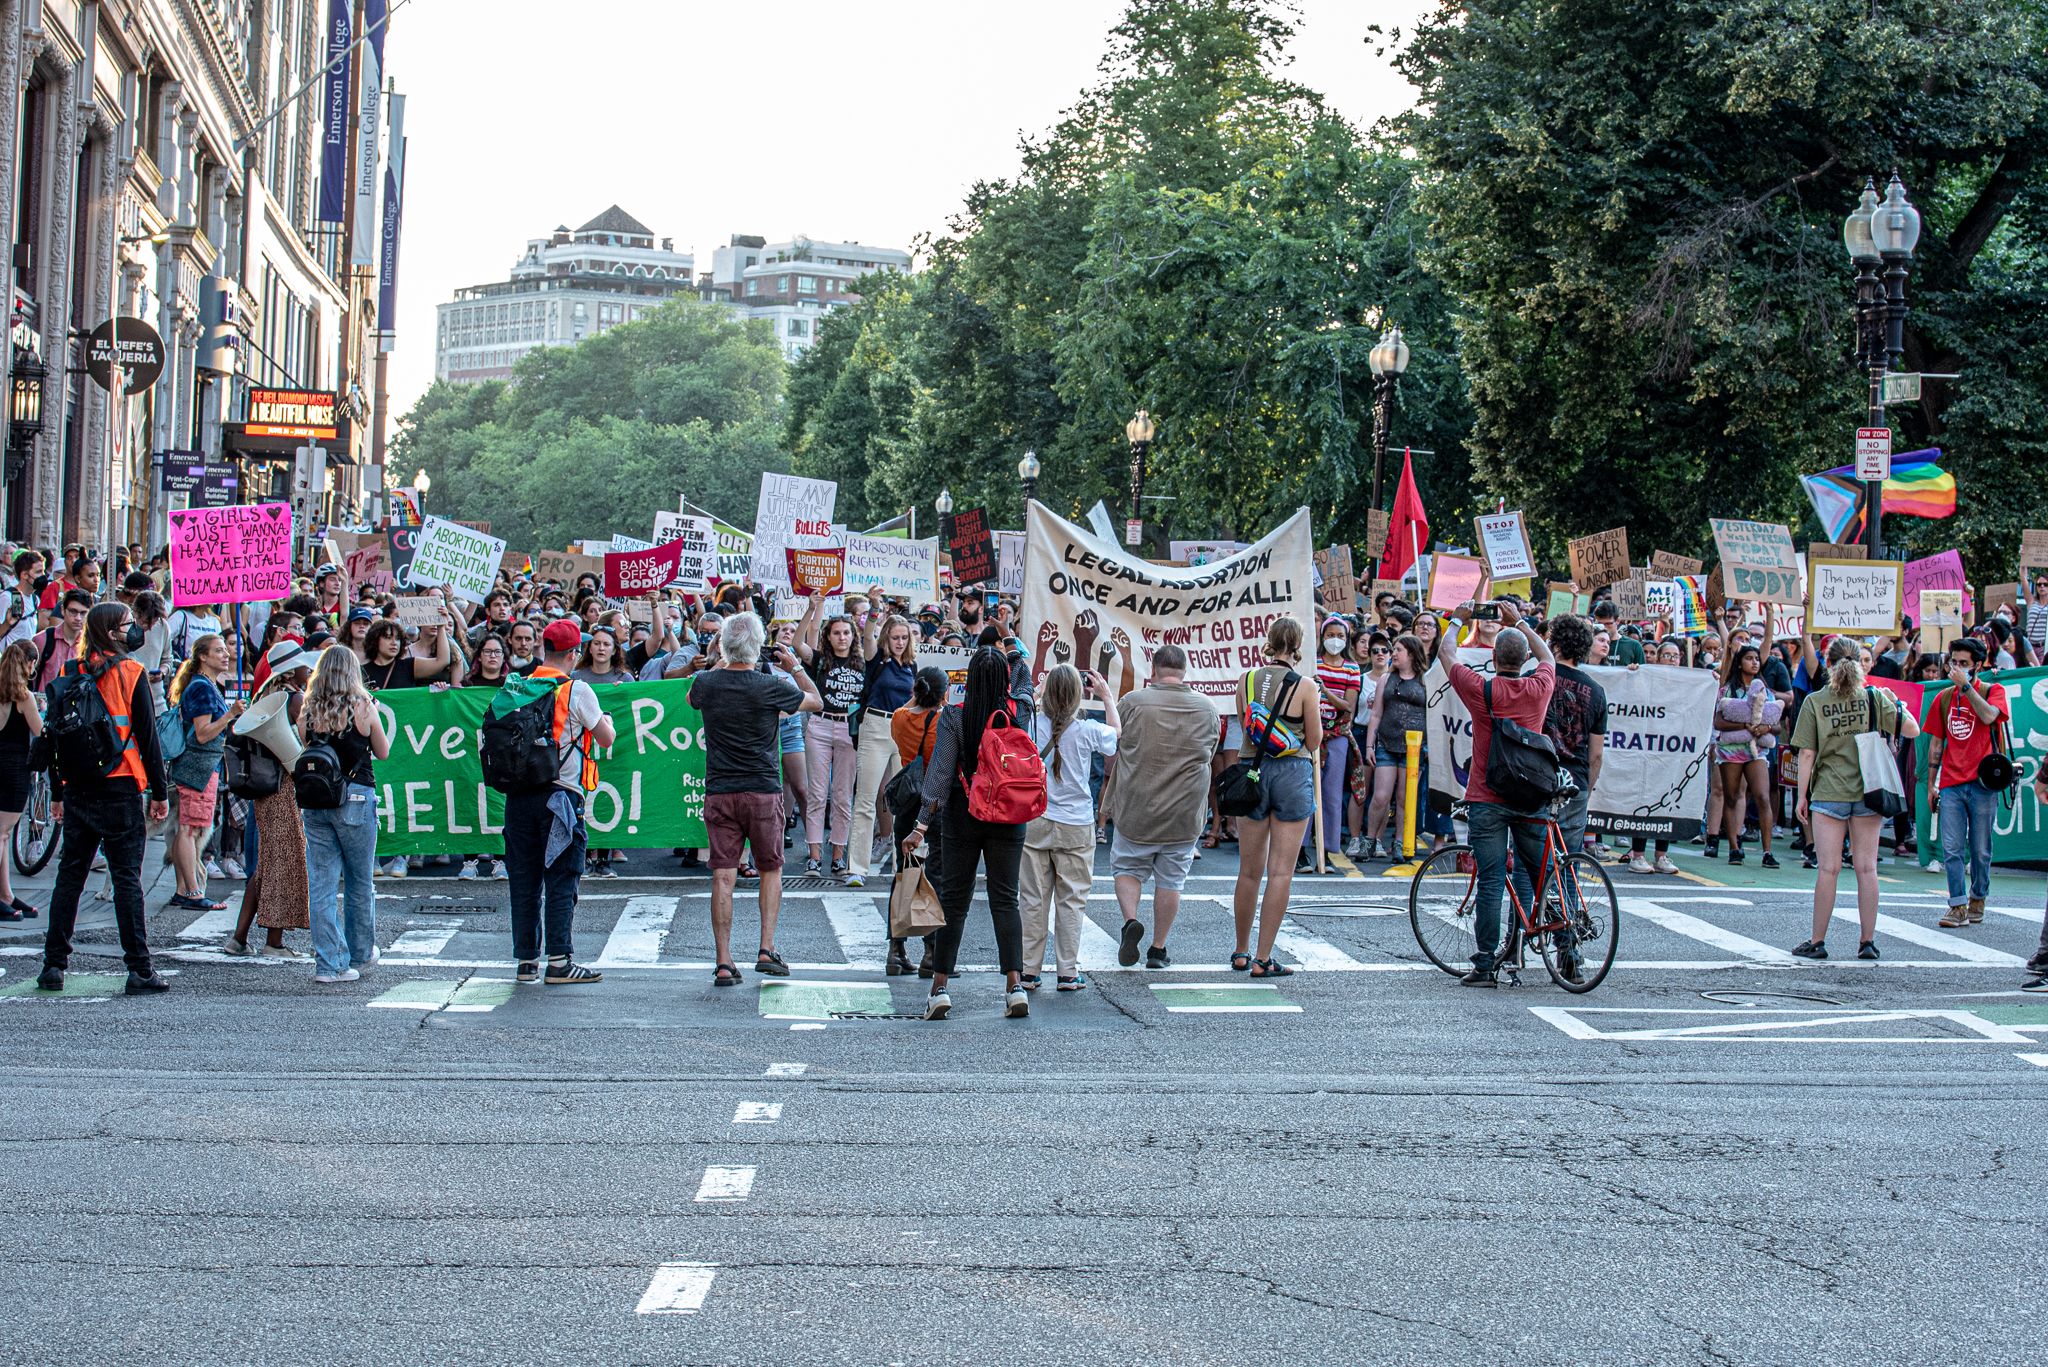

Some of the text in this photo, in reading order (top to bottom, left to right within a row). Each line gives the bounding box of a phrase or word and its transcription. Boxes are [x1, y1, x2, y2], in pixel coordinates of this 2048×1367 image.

[327, 19, 349, 145] Emerson College
[359, 85, 380, 197] Emerson College
[382, 201, 397, 287] Emerson College
[96, 339, 110, 349] EL
[251, 391, 333, 406] THE NEIL DIAMOND MUSICAL
[251, 402, 335, 426] A BEAUTIFUL NOISE
[169, 453, 200, 462] Emerson
[166, 475, 200, 484] Print-Copy
[205, 492, 228, 500] Building
[768, 474, 833, 506] IF MY
[205, 506, 261, 525] GIRLS
[391, 508, 417, 516] PARTY
[767, 497, 822, 519] UTERUS
[675, 518, 695, 529] THE
[954, 510, 980, 524] FIGHT
[1486, 520, 1514, 529] STOP
[185, 522, 290, 542] JUST WANNA
[758, 514, 831, 537] SHOT BULLETS
[957, 521, 982, 537] FIGHT
[1714, 520, 1776, 533] YESTERDAY
[432, 526, 493, 558] ABORTION
[662, 527, 705, 541] SYSTEM
[949, 529, 990, 548] ABORTION
[1569, 528, 1625, 549] THEY CARE ABOUT
[1752, 533, 1791, 546] PERSON
[179, 537, 288, 559] HAVE FUN-
[752, 544, 786, 563] STO
[849, 538, 930, 560] REPRODUCTIVE
[961, 544, 981, 557] IS A
[1495, 549, 1519, 557] FORCED
[1722, 541, 1781, 557] TODAY
[1829, 545, 1866, 559] ONLY
[197, 553, 285, 573] DAMENTAL
[422, 541, 491, 578] IS ESSENTIAL
[540, 557, 575, 574] PRO
[620, 556, 656, 571] BANS
[684, 556, 702, 568] FOR
[796, 553, 837, 566] ABORTION
[849, 555, 920, 571] RIGHTS ARE
[955, 554, 988, 571] HUMAN
[1064, 543, 1273, 591] LEGAL ABORTION
[1583, 559, 1614, 575] NOT THE
[1659, 553, 1697, 572] CAN'T BE
[1919, 558, 1950, 571] LEGAL
[413, 559, 458, 585] HEALTH
[460, 574, 489, 596] CARE
[619, 560, 673, 580] OFF OUR
[678, 567, 704, 579] LISM!
[797, 564, 837, 577] IS HEALTH
[1652, 565, 1681, 577] TRUSTED
[175, 571, 290, 595] HUMAN RIGHTS
[620, 571, 668, 589] BODIES
[804, 575, 827, 587] CARE!
[846, 572, 931, 591] HUMAN RIGHTS
[1578, 567, 1624, 590] UNBORN!
[1733, 568, 1797, 598] BODY
[1846, 576, 1870, 590] pussy
[1871, 571, 1895, 585] bites
[1048, 571, 1293, 617] ONCE AND FOR ALL!
[1323, 587, 1347, 603] KILL
[1141, 627, 1161, 645] WE
[1163, 623, 1206, 645] WON'T
[1211, 620, 1235, 643] GO
[918, 645, 960, 655] SCALES OF
[1188, 645, 1275, 669] FIGHT BAC
[828, 666, 865, 681] OUR BODIES
[837, 675, 856, 683] OUR
[825, 679, 864, 693] FUTURES
[1577, 682, 1592, 697] LEE
[835, 692, 855, 700] OUR
[1607, 702, 1667, 719] CHAINS
[1831, 713, 1868, 728] DEPT.
[1602, 731, 1697, 753] ERATION
[376, 771, 642, 835] HELL O!
